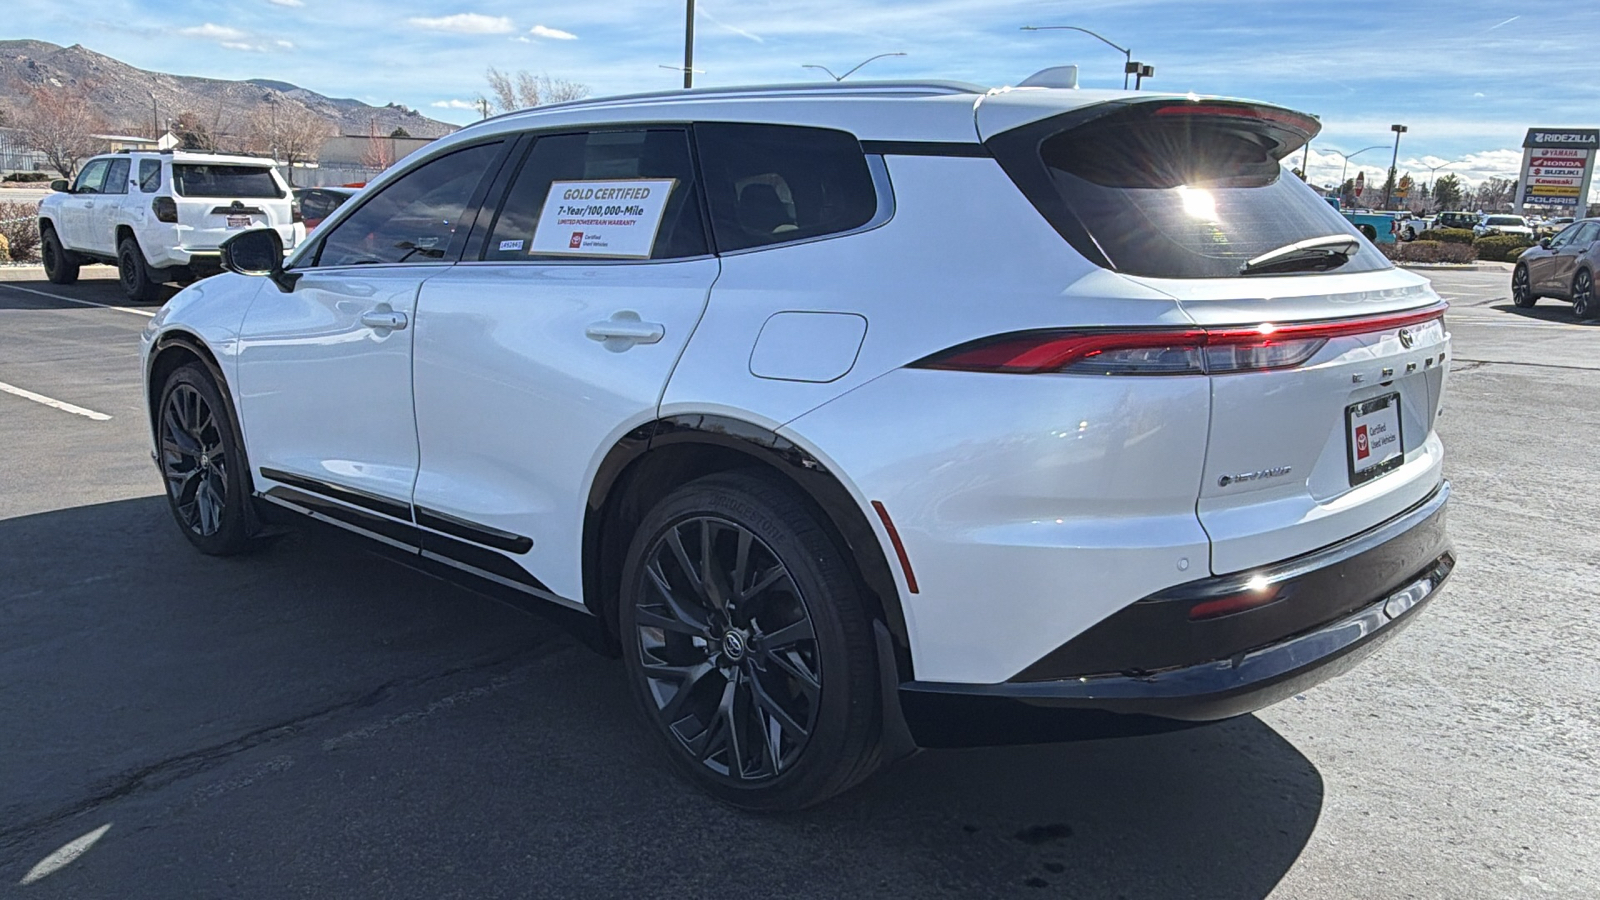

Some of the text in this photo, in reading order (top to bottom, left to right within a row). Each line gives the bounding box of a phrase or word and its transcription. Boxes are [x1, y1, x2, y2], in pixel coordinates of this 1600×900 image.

[1544, 134, 1596, 143] RIDEZILLA
[563, 187, 650, 200] GOLD CERTIFIED
[1526, 196, 1577, 204] POLARIS
[557, 205, 644, 217] 7-Year/100,000-Mile
[1369, 423, 1387, 436] Certified
[1371, 433, 1396, 449] Used Vehicles
